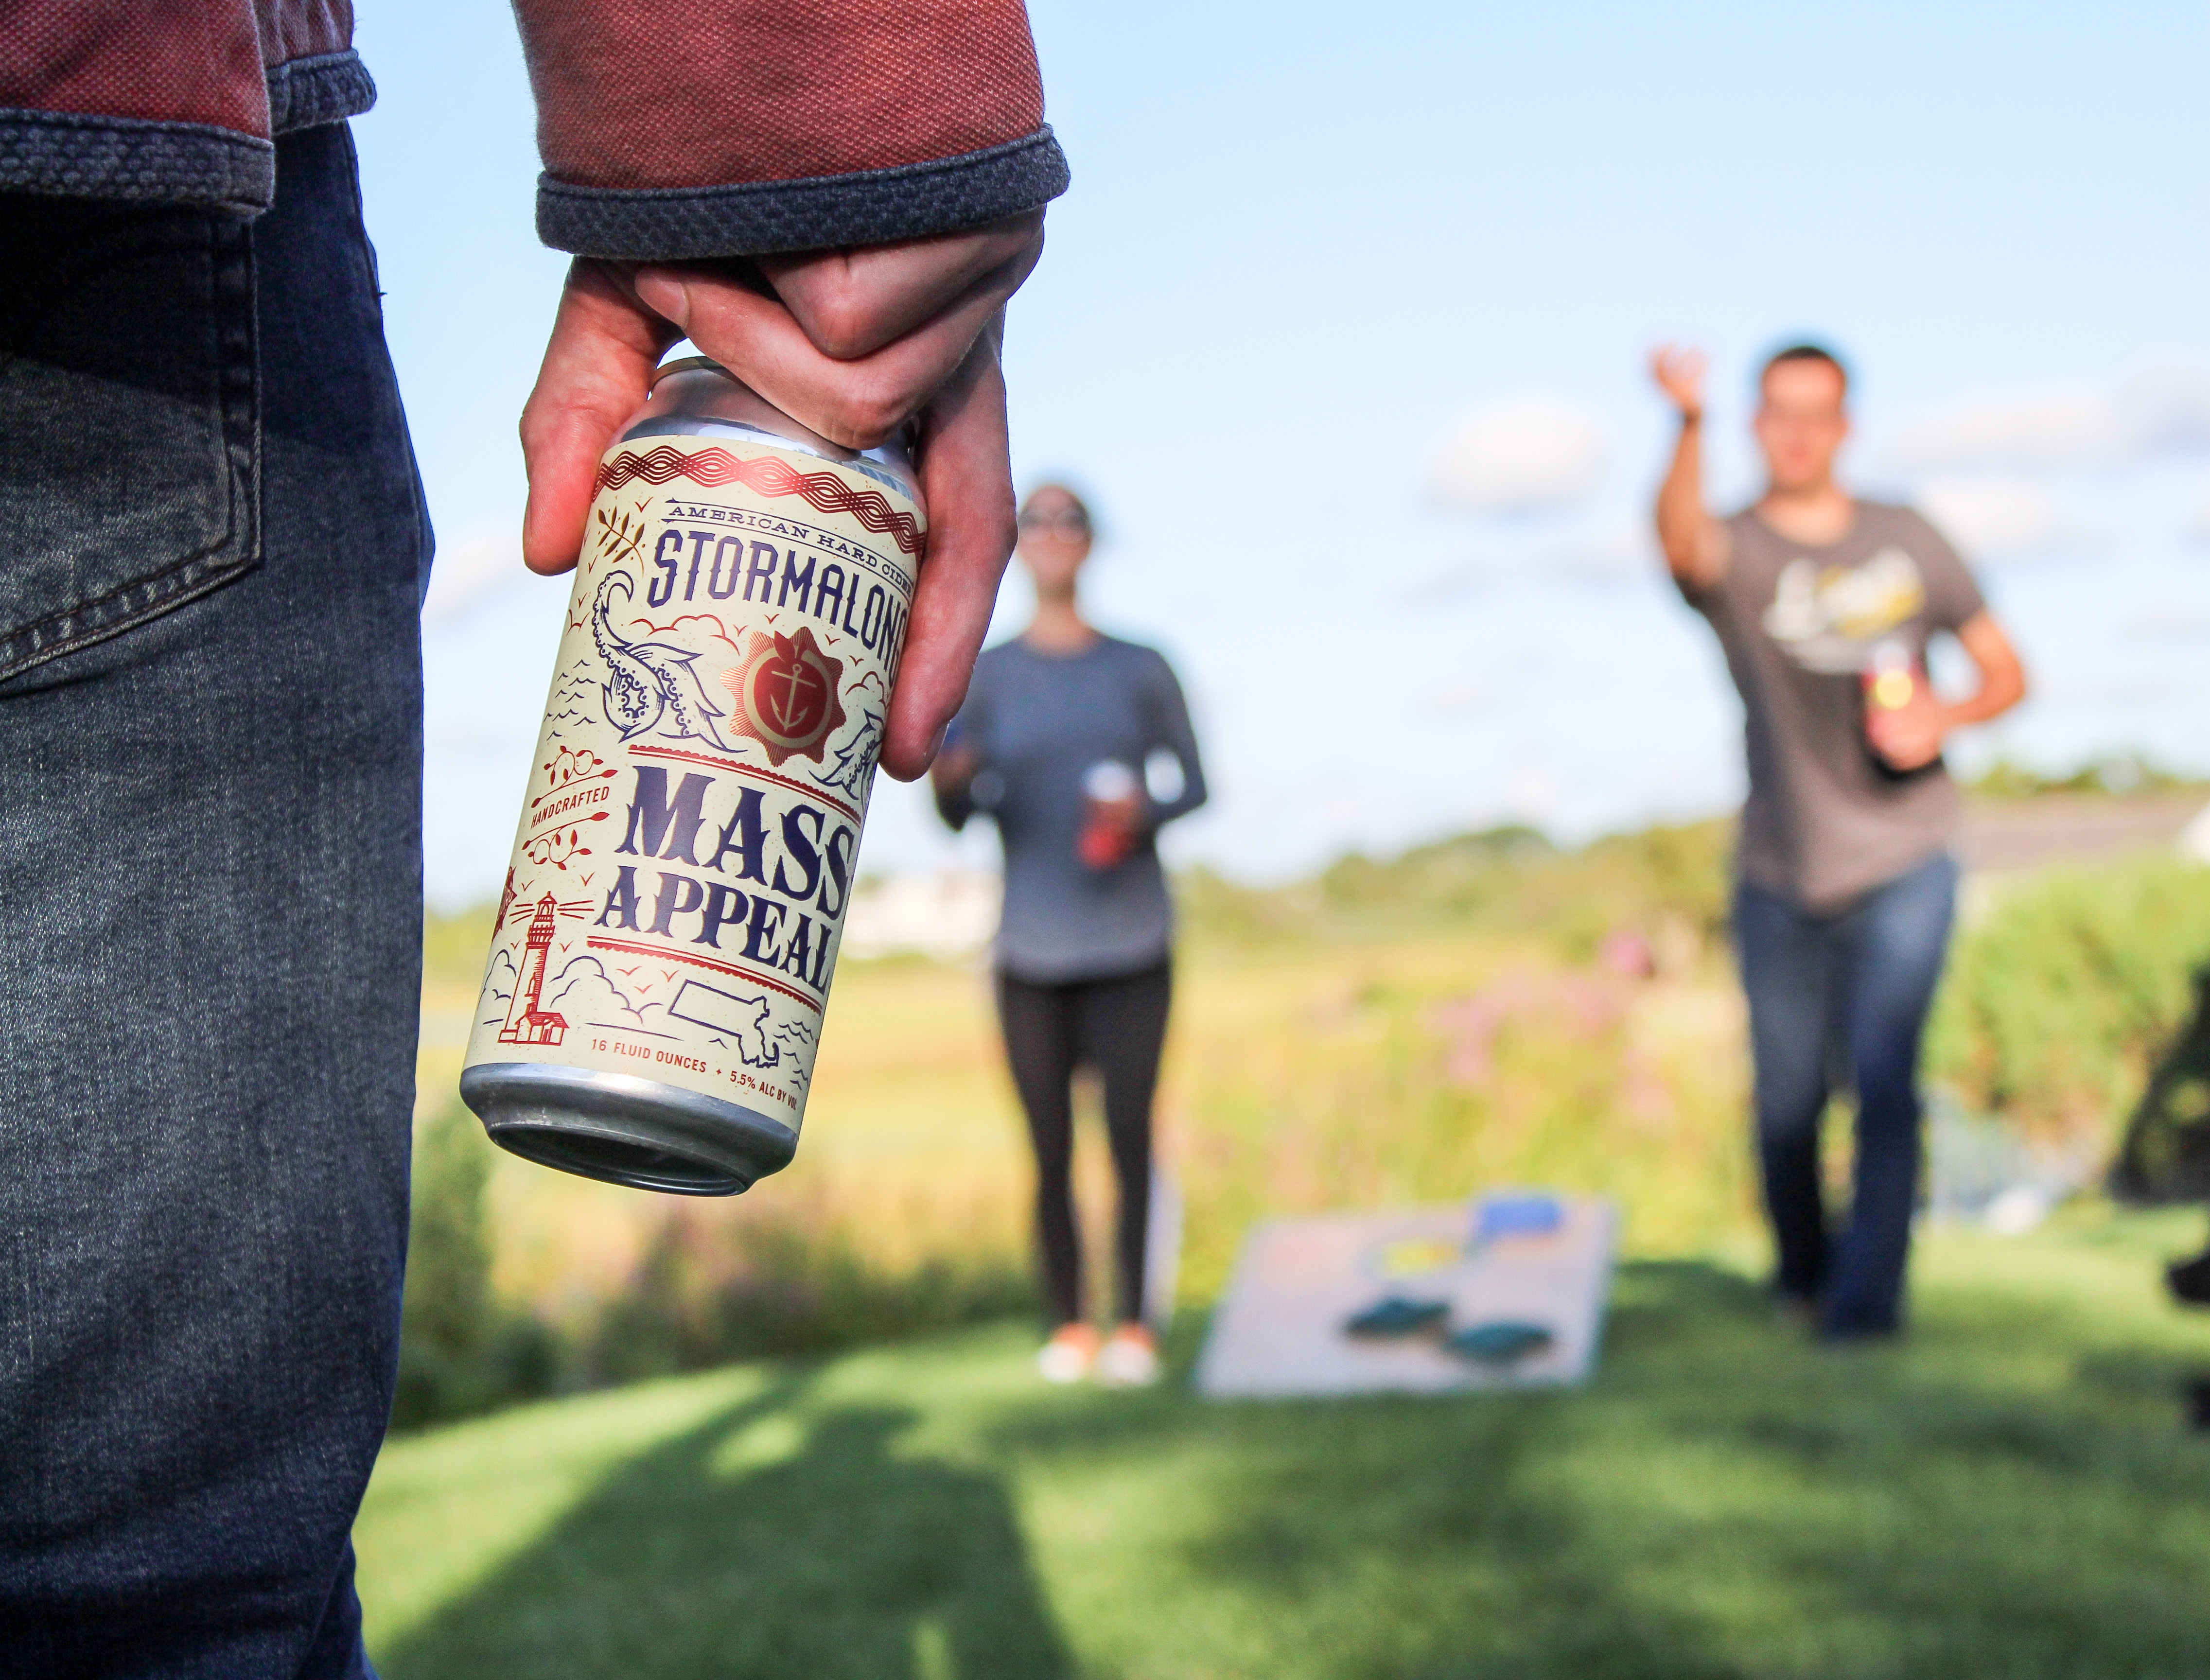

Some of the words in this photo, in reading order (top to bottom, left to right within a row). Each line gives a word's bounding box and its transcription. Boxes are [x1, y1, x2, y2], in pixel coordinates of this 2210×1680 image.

[669, 507, 809, 539] AMERICAN
[817, 535, 877, 567] HARD
[647, 529, 908, 689] STORMALONG
[530, 786, 609, 830] HANDCRAFTED
[614, 766, 855, 921] MASS
[594, 866, 833, 996] APPEAL
[592, 1039, 607, 1050] 16
[613, 1042, 650, 1059] FLUID
[656, 1050, 706, 1072] OUNCES
[730, 1070, 755, 1089] 5.5%
[759, 1081, 775, 1097] ALC
[776, 1089, 787, 1102] BY
[788, 1094, 797, 1110] VOL
